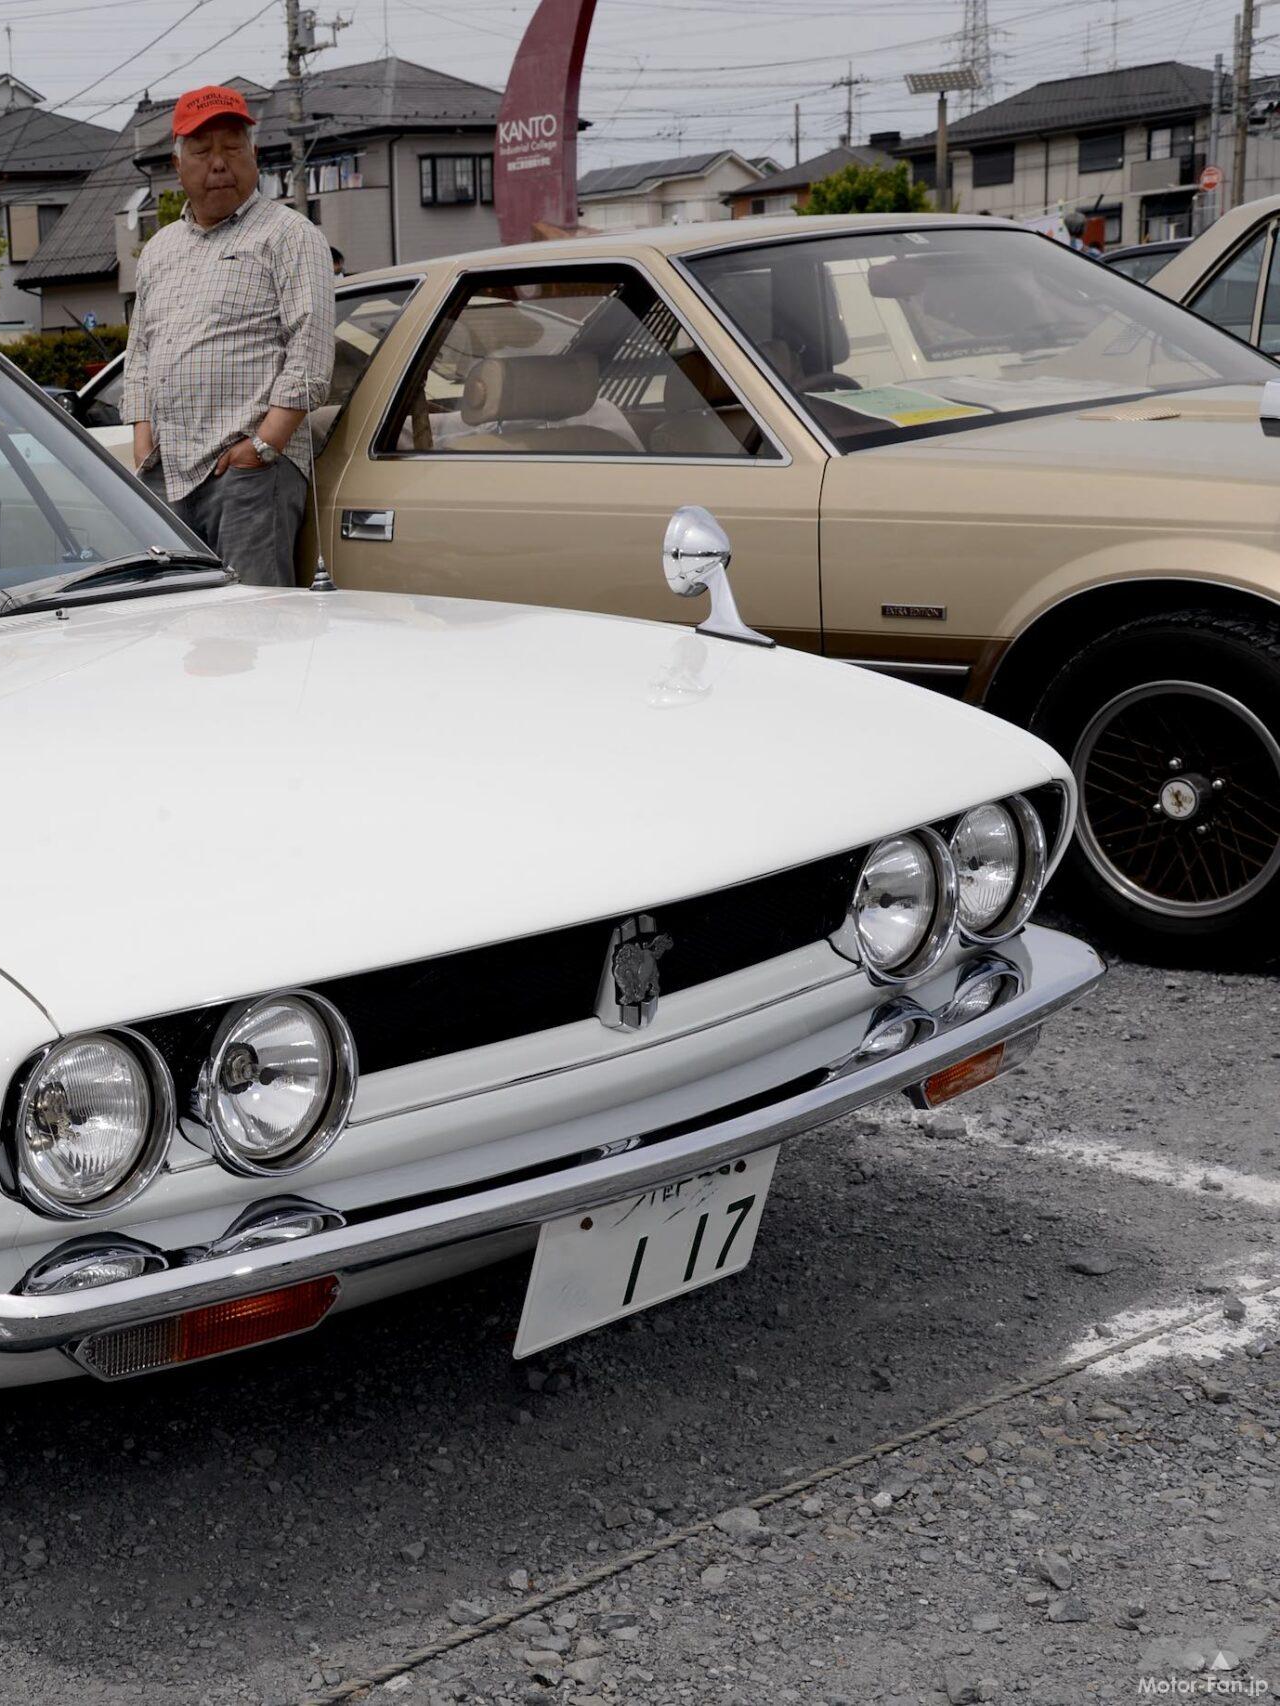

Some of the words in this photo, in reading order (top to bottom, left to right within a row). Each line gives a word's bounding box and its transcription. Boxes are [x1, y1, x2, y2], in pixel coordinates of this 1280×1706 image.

[499, 114, 557, 144] KANTO
[499, 142, 529, 156] Industrial
[531, 140, 557, 151] College
